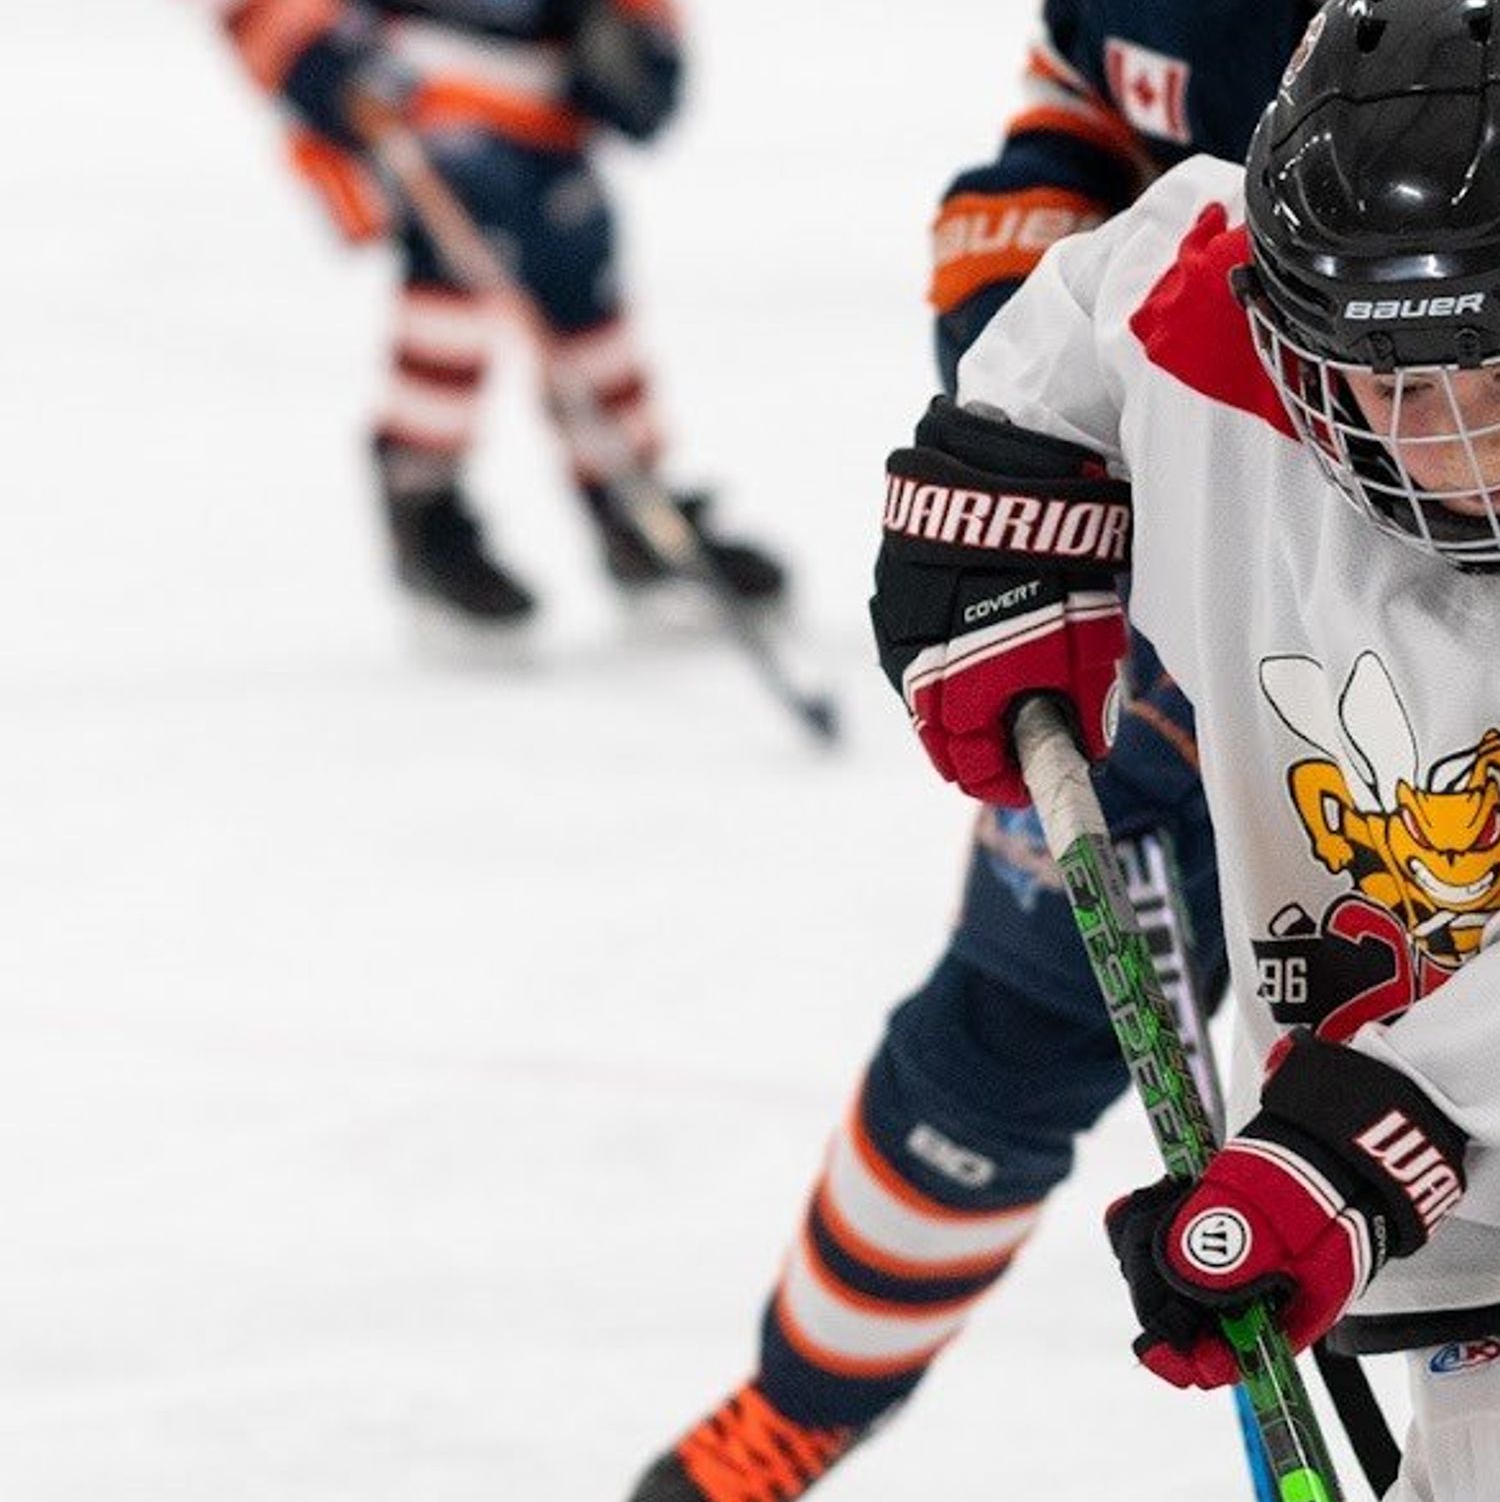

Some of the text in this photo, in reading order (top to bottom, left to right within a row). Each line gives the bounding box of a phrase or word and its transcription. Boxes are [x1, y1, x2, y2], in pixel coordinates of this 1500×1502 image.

[1344, 291, 1485, 320] BAUER
[884, 473, 1130, 561] WARRIOR
[963, 580, 1041, 624] COVERT
